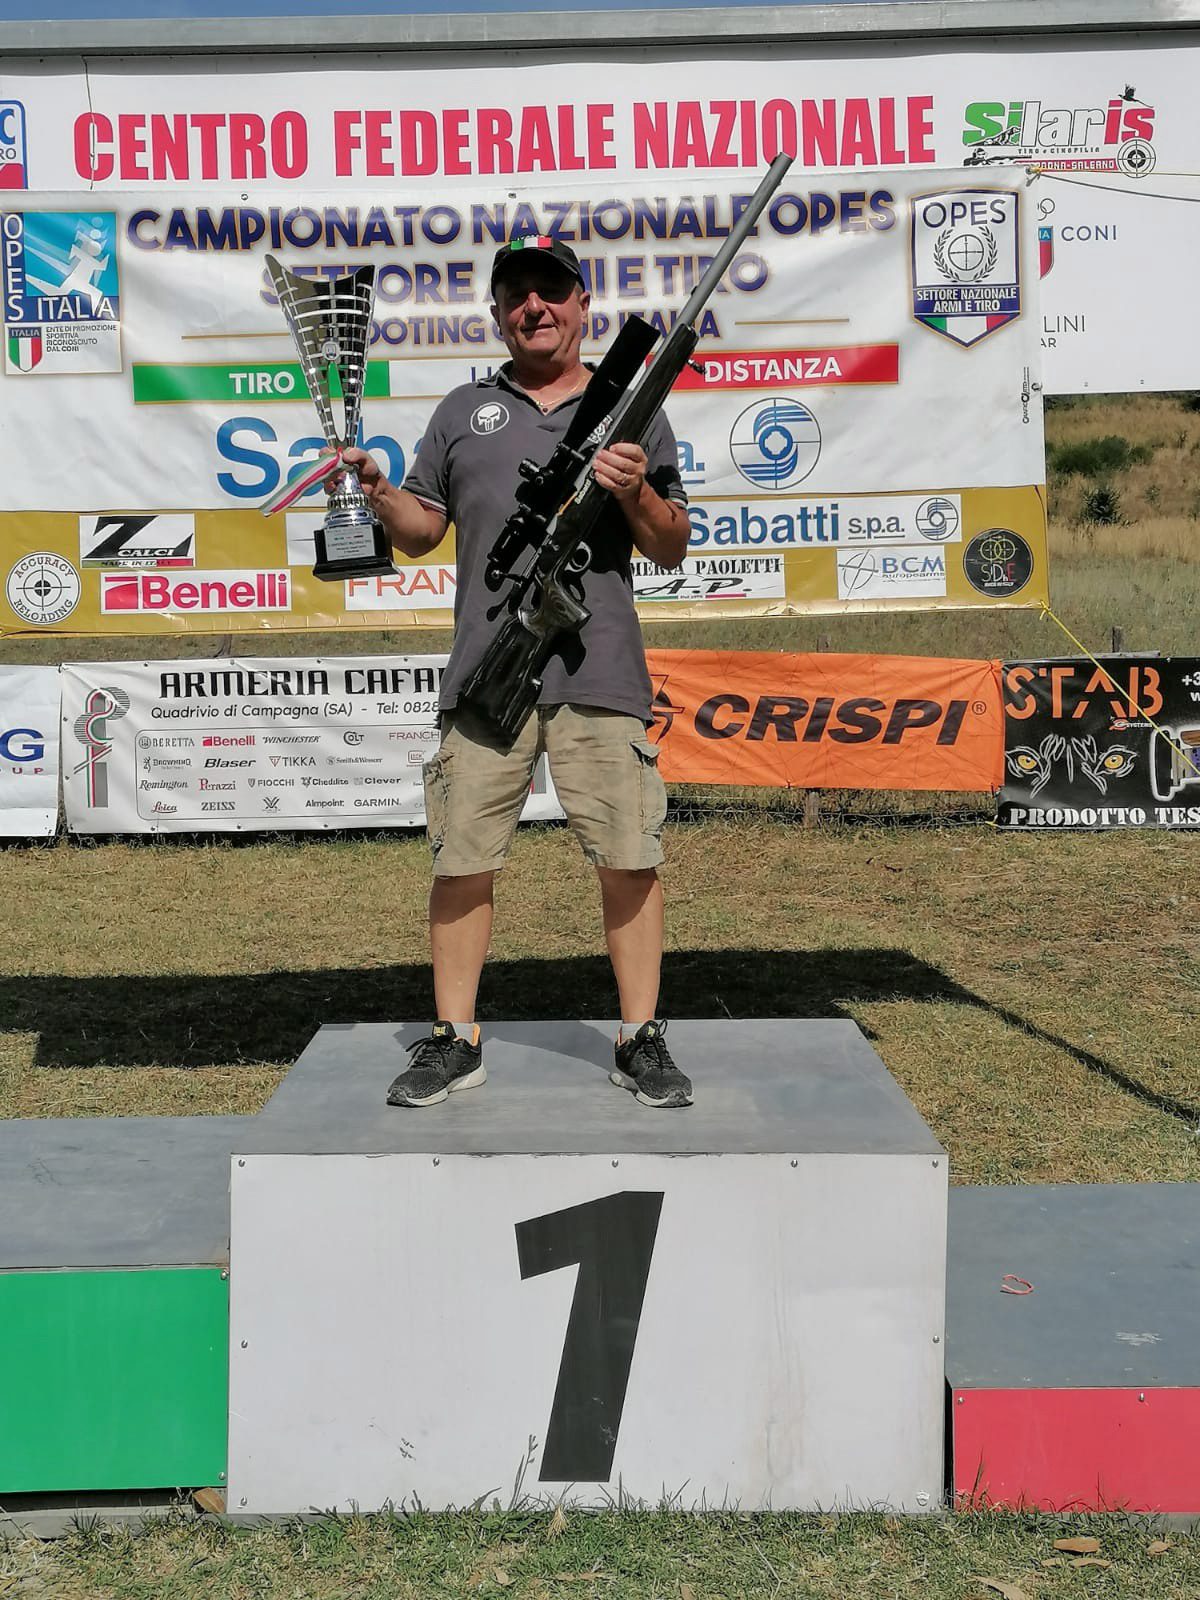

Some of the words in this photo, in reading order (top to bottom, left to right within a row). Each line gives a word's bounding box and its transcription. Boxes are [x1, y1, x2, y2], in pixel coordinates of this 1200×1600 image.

[963, 100, 1155, 150] Silaris
[73, 111, 308, 184] CENTRO
[334, 104, 617, 178] FEDERALE
[632, 96, 935, 171] NAZIONALE
[127, 205, 462, 254] CAMPIONATO
[470, 195, 759, 244] NAZIONALE
[768, 189, 897, 238] OPES
[923, 199, 1008, 231] OPES
[1061, 224, 1117, 242] CONI
[4, 213, 26, 322] OPES
[616, 257, 644, 297] E
[917, 289, 959, 301] SETTORE
[961, 287, 1017, 300] NAZIONALE
[933, 301, 962, 313] ARMI
[965, 300, 973, 312] E
[974, 299, 1001, 311] TIRO
[37, 296, 116, 322] ITALIA
[11, 329, 41, 338] ITALIA
[703, 356, 842, 384] DISTANZA
[229, 372, 296, 395] TIRO
[687, 503, 839, 547] Sabatti
[848, 514, 905, 541] s.p.a.
[118, 548, 176, 558] CALCI
[882, 557, 945, 574] BCM
[14, 555, 75, 580] ACCURACY
[695, 558, 781, 575] PAOLETTI
[142, 573, 288, 610] Benelli
[13, 597, 75, 623] RELOADING
[159, 669, 331, 700] ARMERIA
[1004, 666, 1164, 720] STAB
[152, 704, 219, 721] Quadrivio
[224, 703, 238, 718] di
[241, 702, 319, 722] Campagna
[324, 701, 354, 719] (SA)
[377, 702, 399, 714] Tel:
[403, 701, 440, 714] 0828
[153, 737, 196, 748] BERETTA
[212, 736, 256, 748] Benelli
[262, 735, 321, 744] WINCHESTER
[343, 731, 365, 746] COLT
[388, 731, 440, 741] FRANCH
[204, 758, 257, 769] Blaser
[282, 756, 317, 767] TIKKA
[139, 779, 189, 792] Remington
[199, 778, 237, 791] Perazzi
[257, 778, 296, 787] FIOCCHI
[364, 777, 402, 785] Clever
[151, 801, 178, 814] Leica
[353, 798, 400, 808] GARMIN
[1009, 807, 1148, 826] PRODOTTO
[513, 1190, 666, 1483] 1
